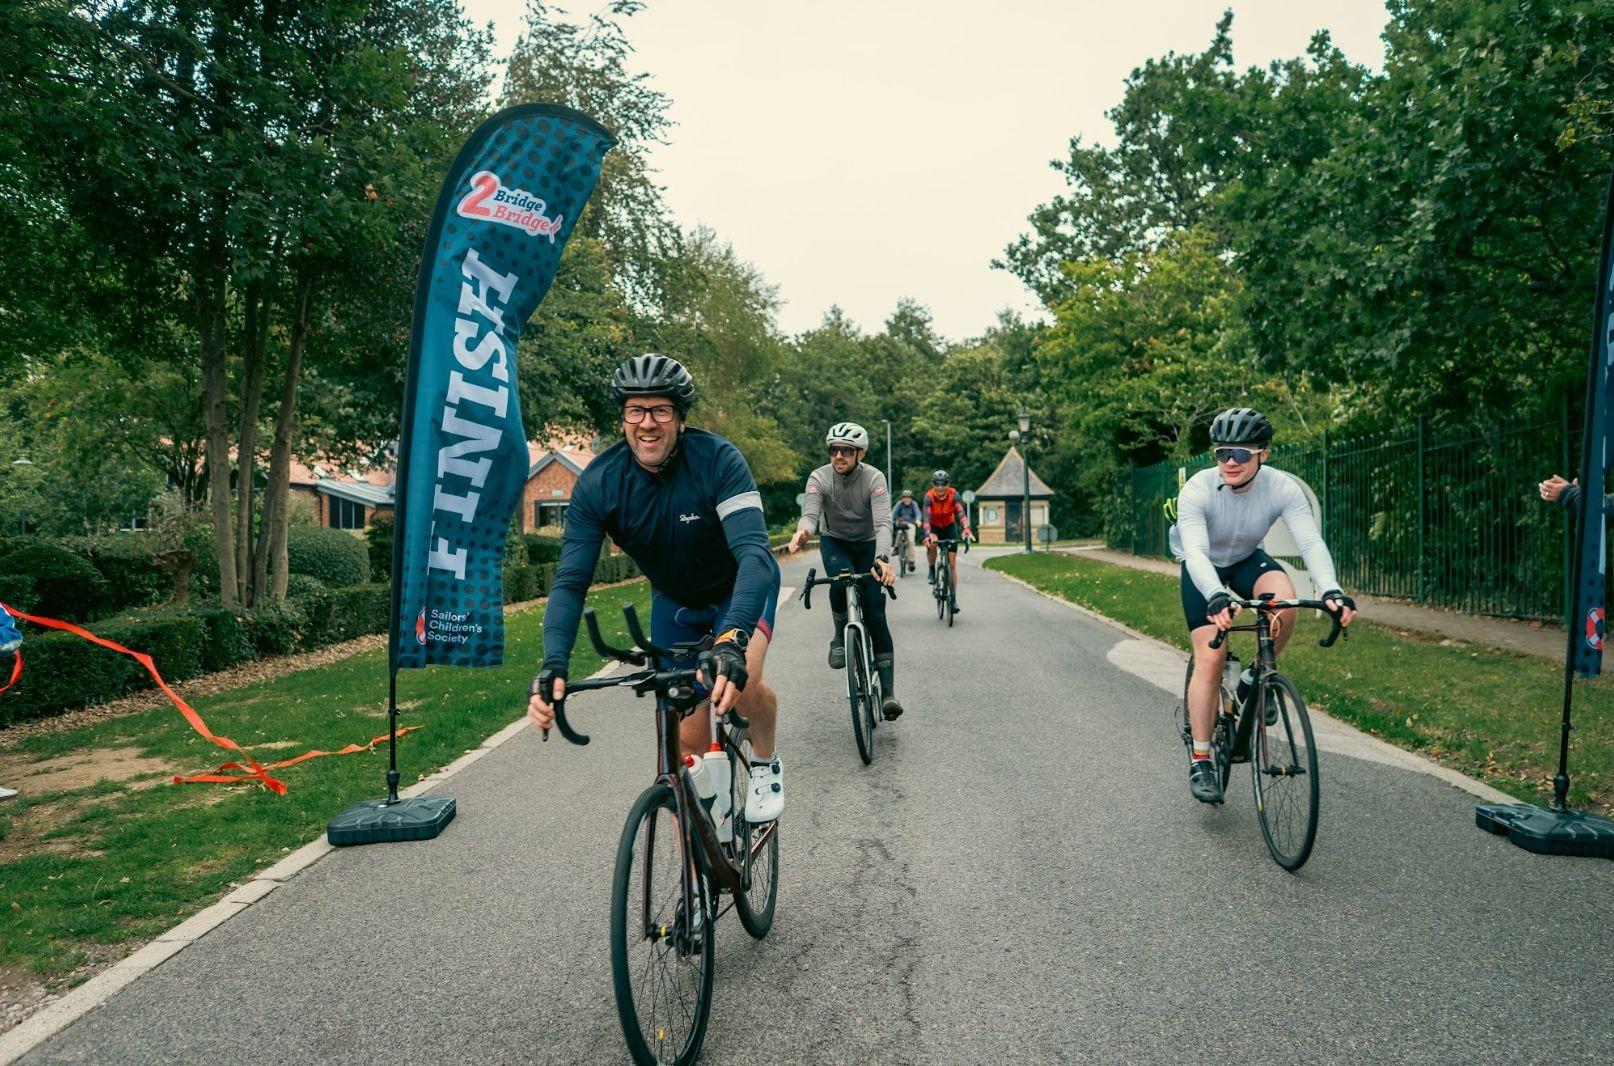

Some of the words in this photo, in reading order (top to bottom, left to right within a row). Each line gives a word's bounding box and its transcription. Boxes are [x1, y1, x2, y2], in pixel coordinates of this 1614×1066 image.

[462, 174, 497, 216] 2
[493, 190, 542, 212] Bridge
[493, 205, 549, 231] Bridge
[428, 248, 519, 580] FINISH
[429, 620, 483, 633] Children's
[431, 609, 470, 622] Sailors'
[427, 631, 468, 644] Society
